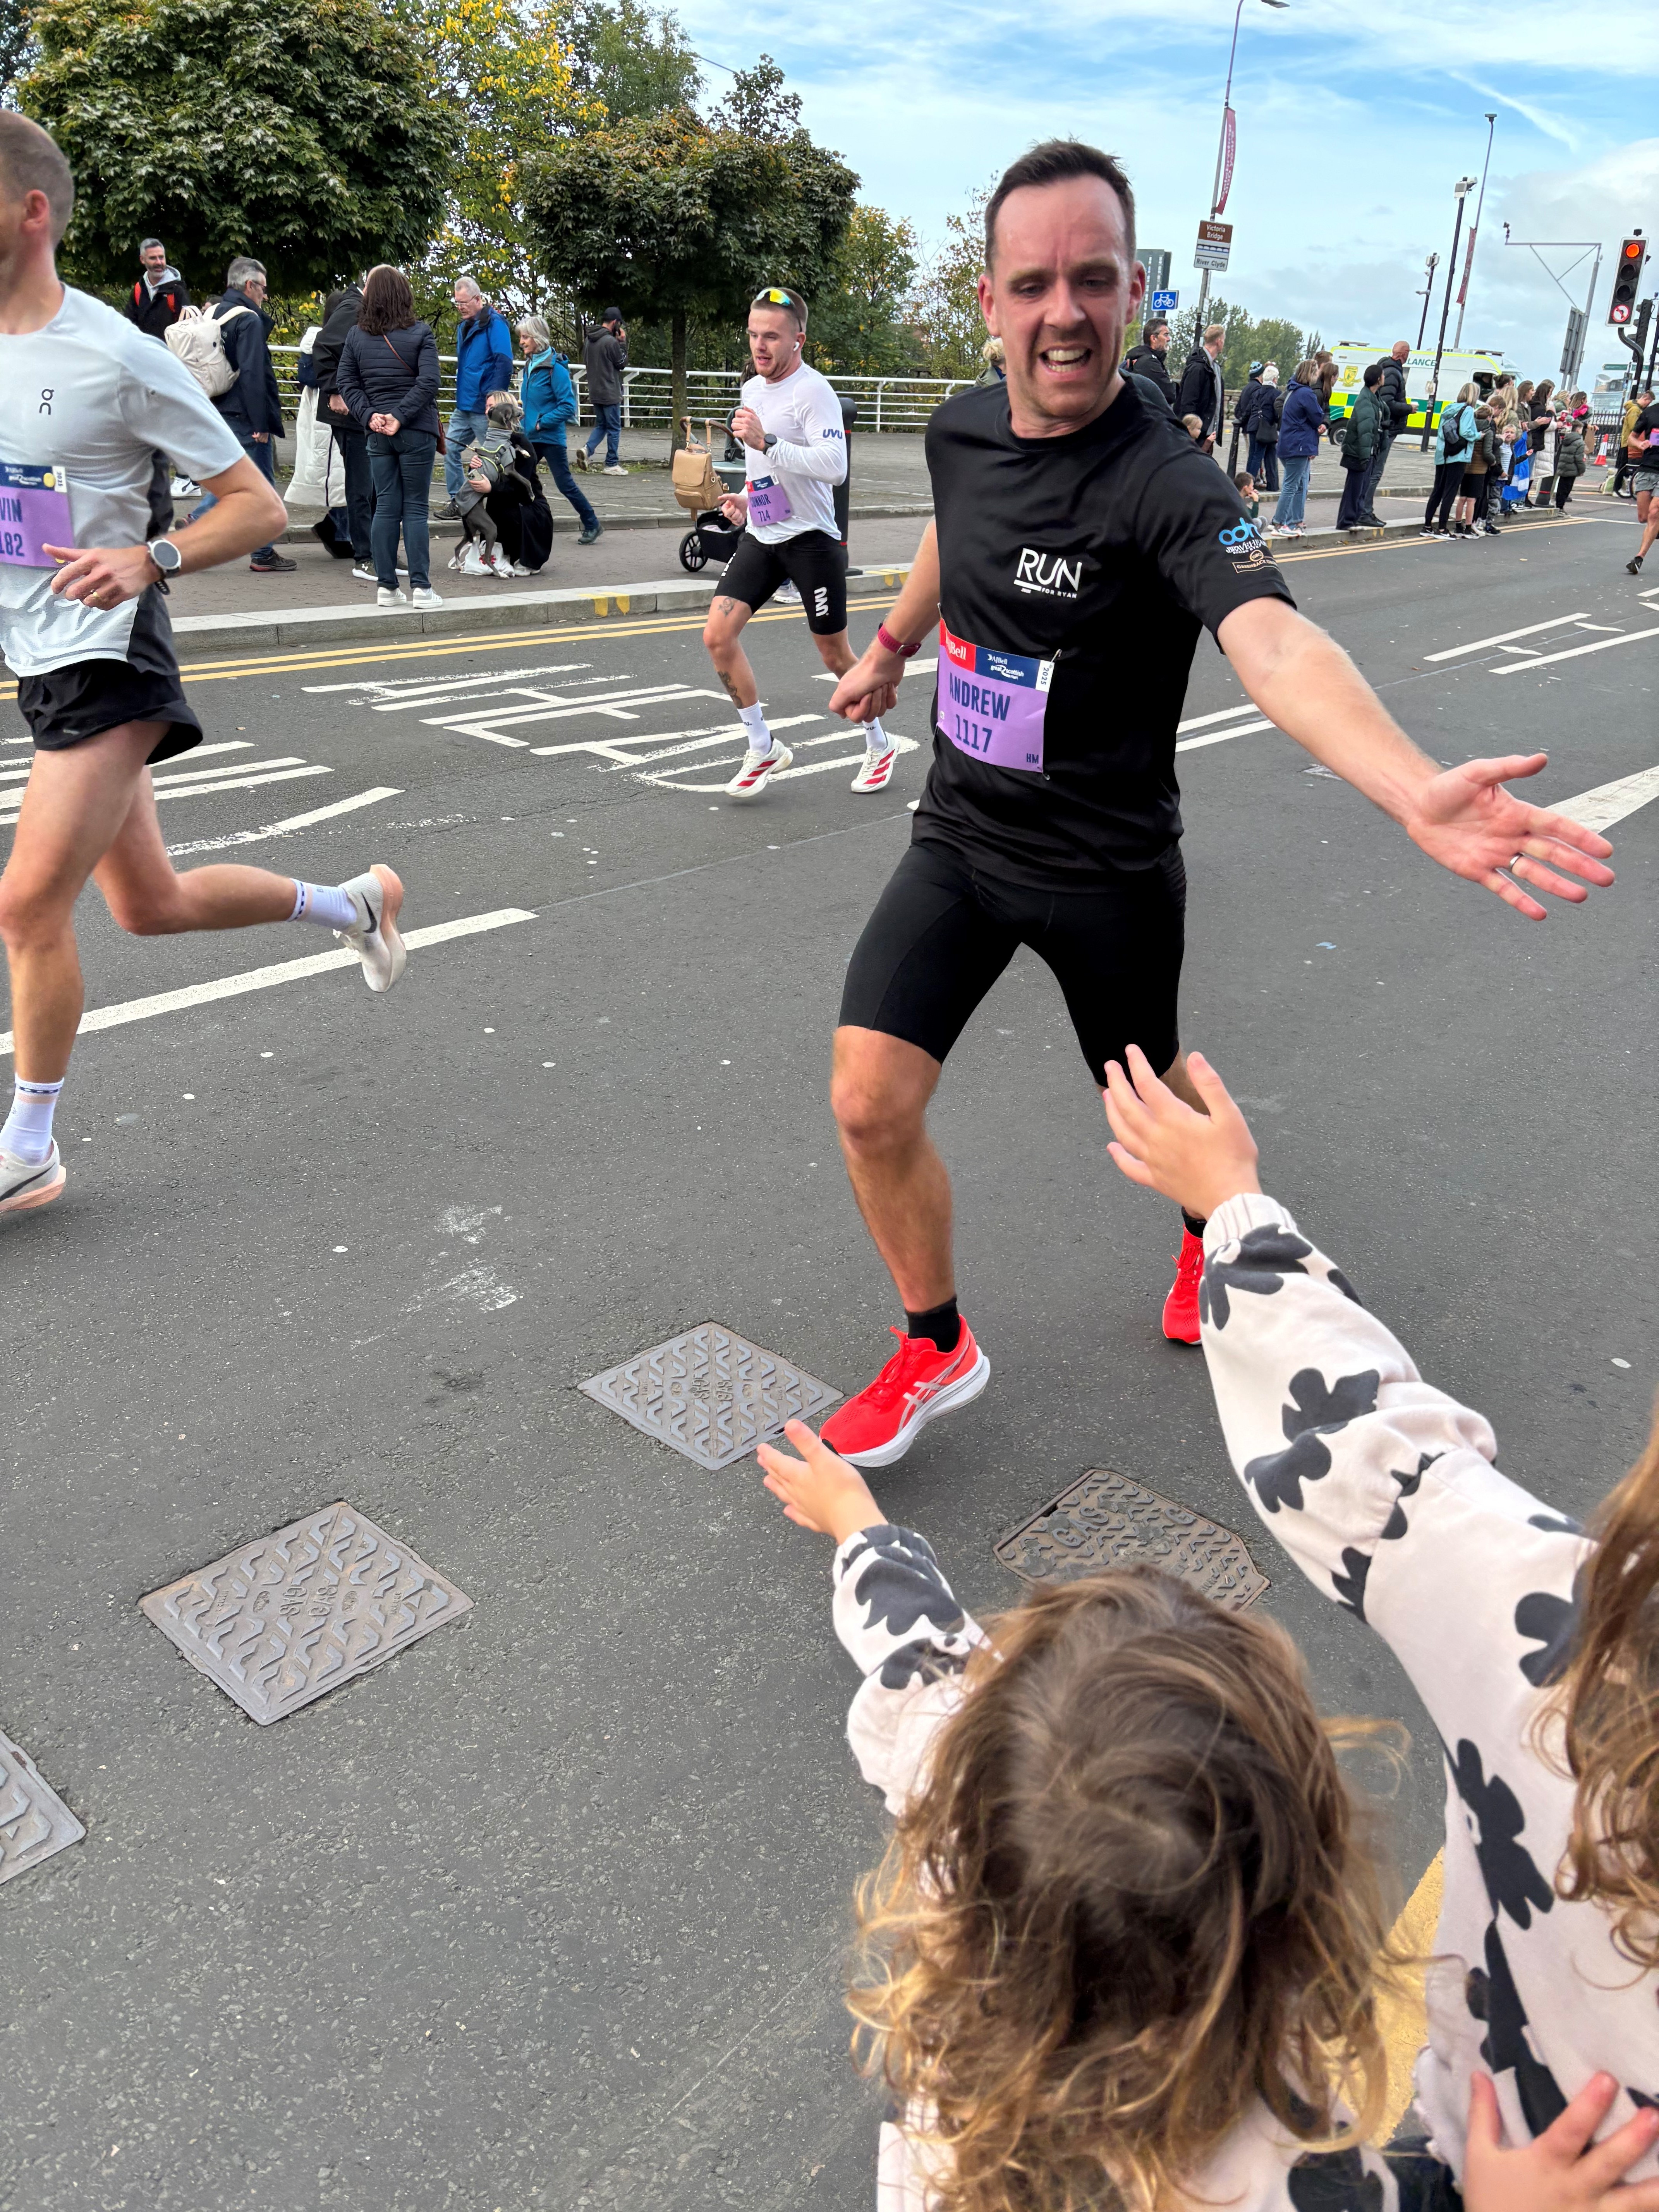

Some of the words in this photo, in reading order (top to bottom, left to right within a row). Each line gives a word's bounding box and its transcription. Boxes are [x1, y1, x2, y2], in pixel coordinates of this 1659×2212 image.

[1206, 224, 1226, 233] Victoria
[1207, 232, 1223, 240] Bridge
[1211, 260, 1225, 268] Clyde
[758, 510, 771, 522] 714
[1017, 548, 1082, 591] RUN
[1041, 667, 1049, 685] 2025
[949, 672, 1011, 721] ANDREW
[955, 714, 992, 753] 1117
[1026, 753, 1039, 764] HM
[1051, 1506, 1109, 1548] GAS
[279, 1587, 307, 1615] GAS
[308, 1587, 338, 1616] GAS
